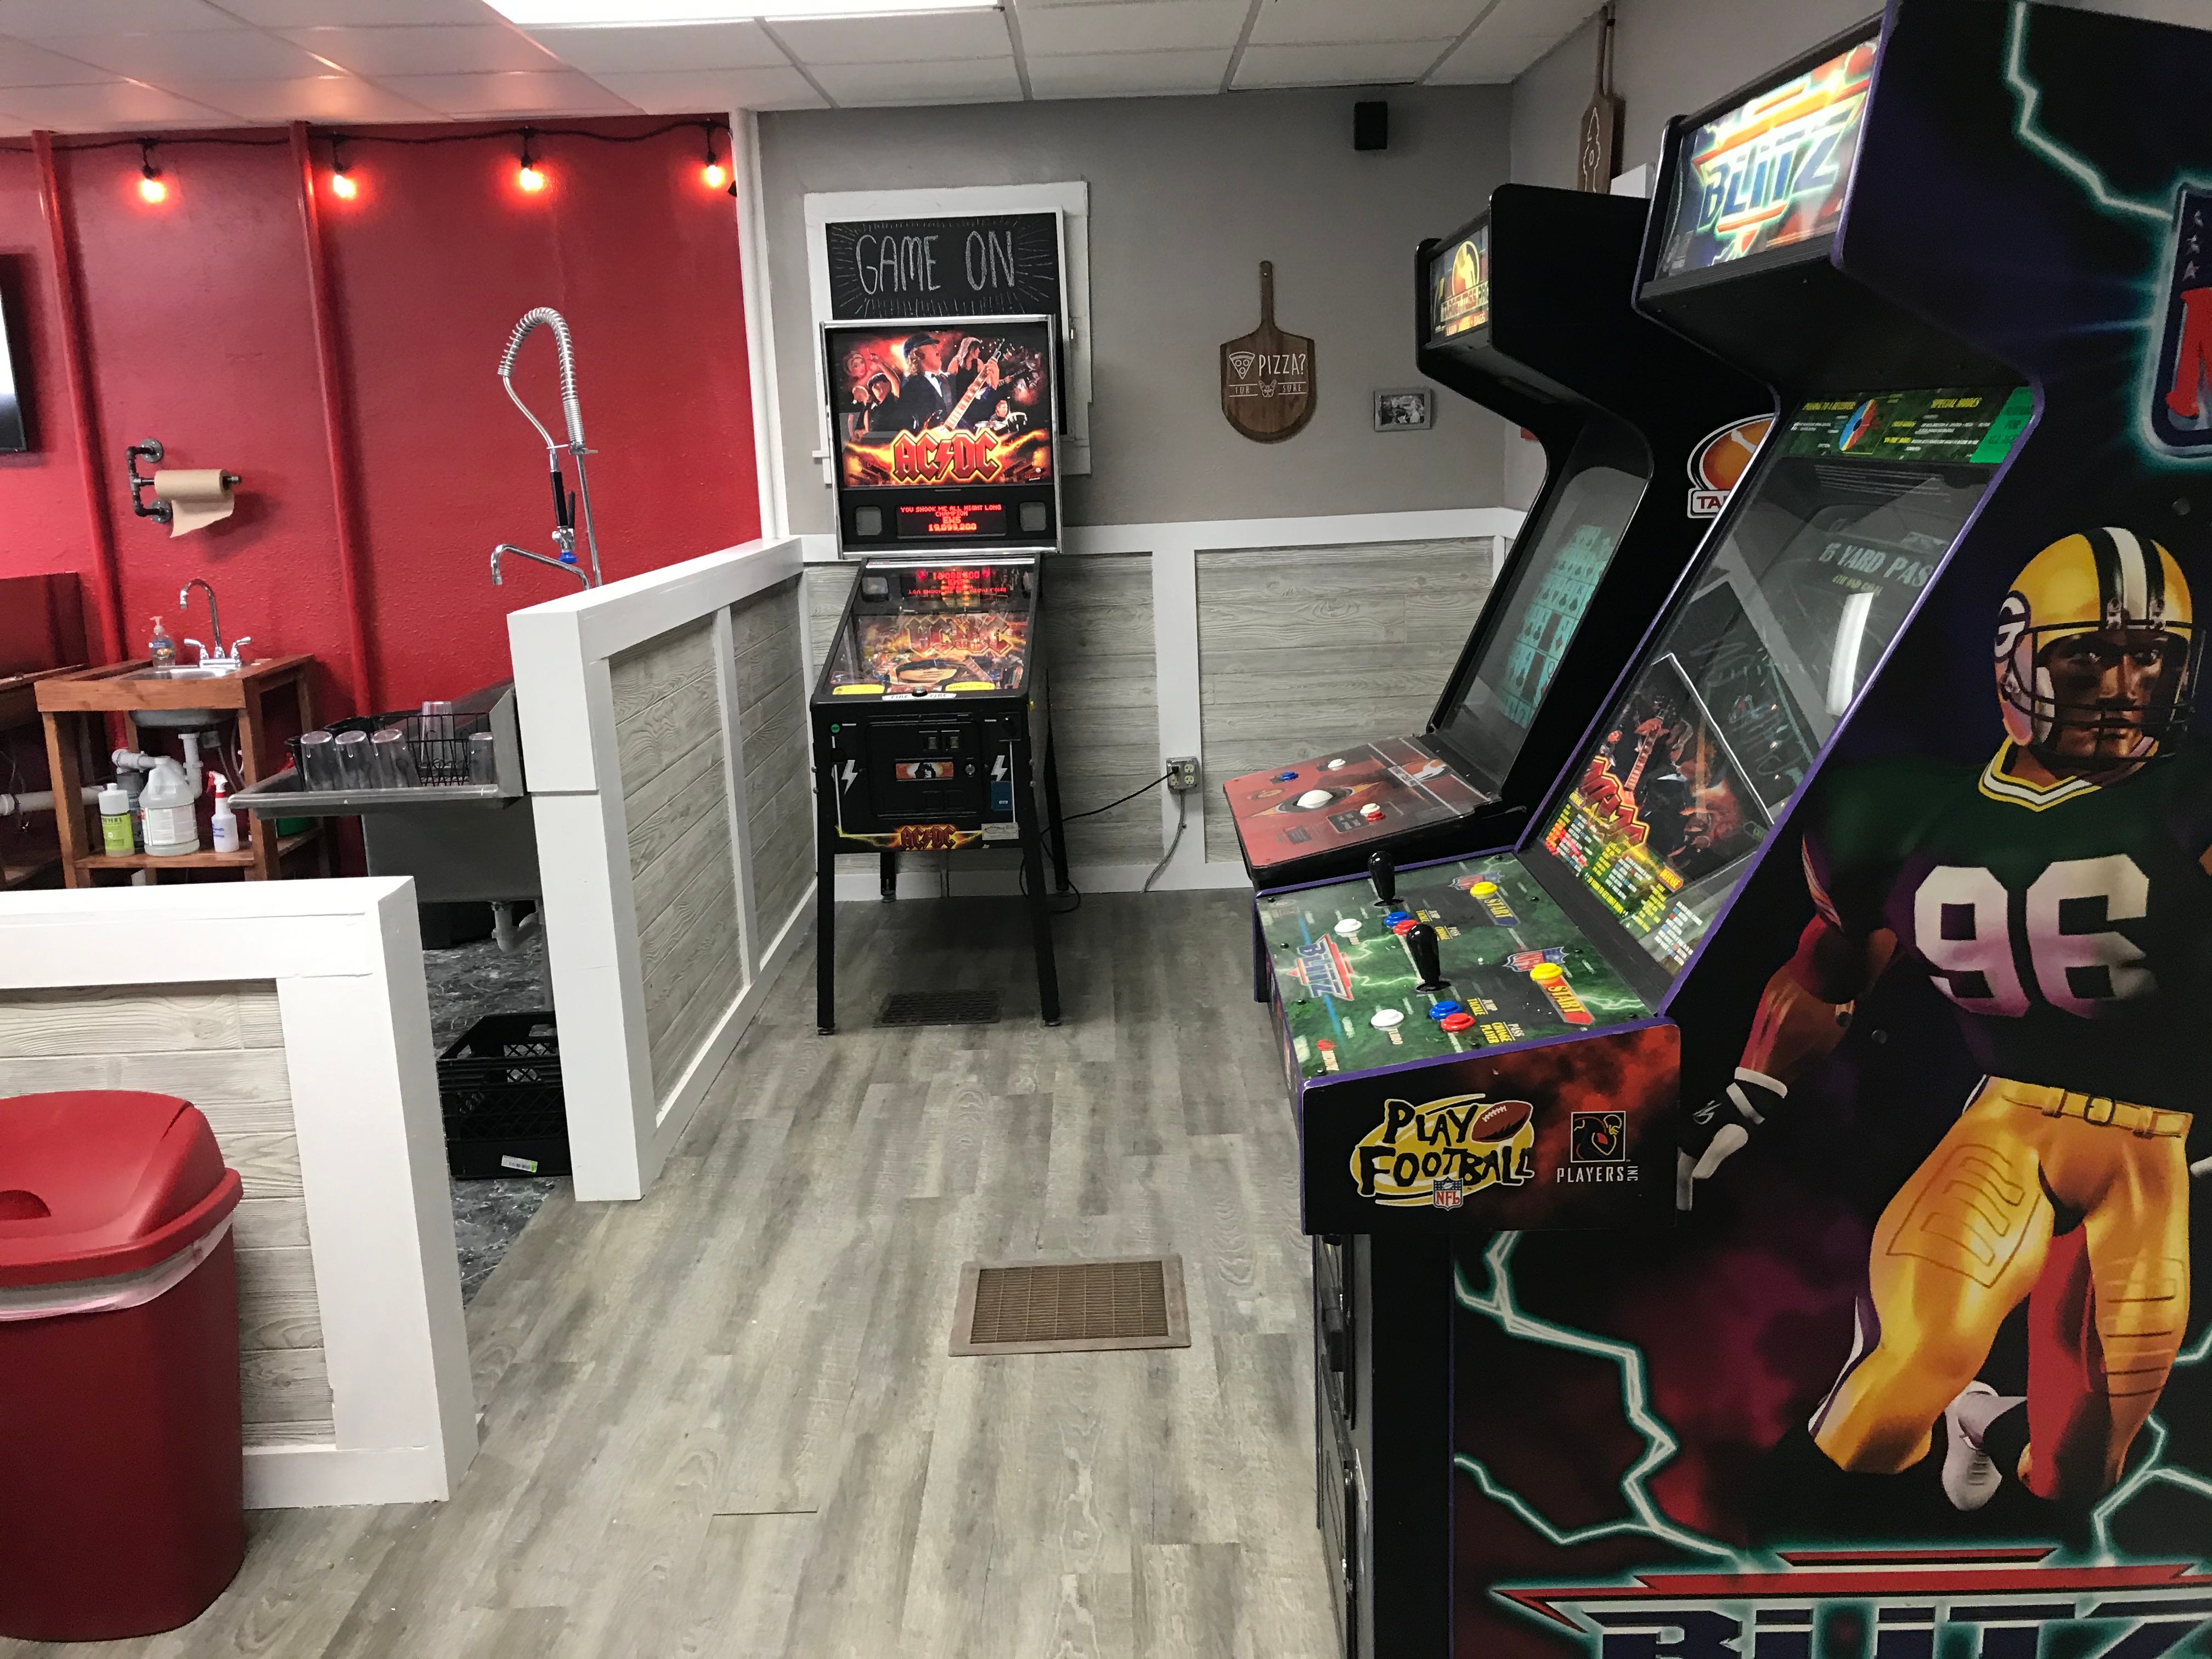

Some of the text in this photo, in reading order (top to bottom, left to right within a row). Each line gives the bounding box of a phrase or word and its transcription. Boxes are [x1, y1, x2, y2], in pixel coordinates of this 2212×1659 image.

[856, 230, 1015, 295] GAME ON
[1259, 353, 1306, 376] PIZZA?
[1235, 384, 1301, 394] FUR SURE
[1837, 545, 1887, 573] YARD
[1883, 556, 1934, 588] PAS
[1660, 868, 1681, 889] DEFENSE
[1484, 899, 1514, 918] START
[1914, 853, 2159, 1019] 96
[1296, 935, 1346, 998] BLITZ
[1467, 997, 1486, 1016] TACKLE
[1482, 998, 1498, 1012] JUMP
[1548, 985, 1585, 1013] START
[1387, 1028, 1403, 1045] TURBO
[1480, 1024, 1500, 1043] PLAYER
[1491, 1022, 1513, 1043] CHANGE
[1508, 1023, 1525, 1037] PASS
[1321, 1050, 1340, 1071] MIDWAY
[1381, 1101, 1479, 1144] PLAY
[1358, 1145, 1535, 1196] FOOTBALL
[1557, 1165, 1639, 1183] PLAYERS INC
[1435, 1190, 1460, 1205] NFL
